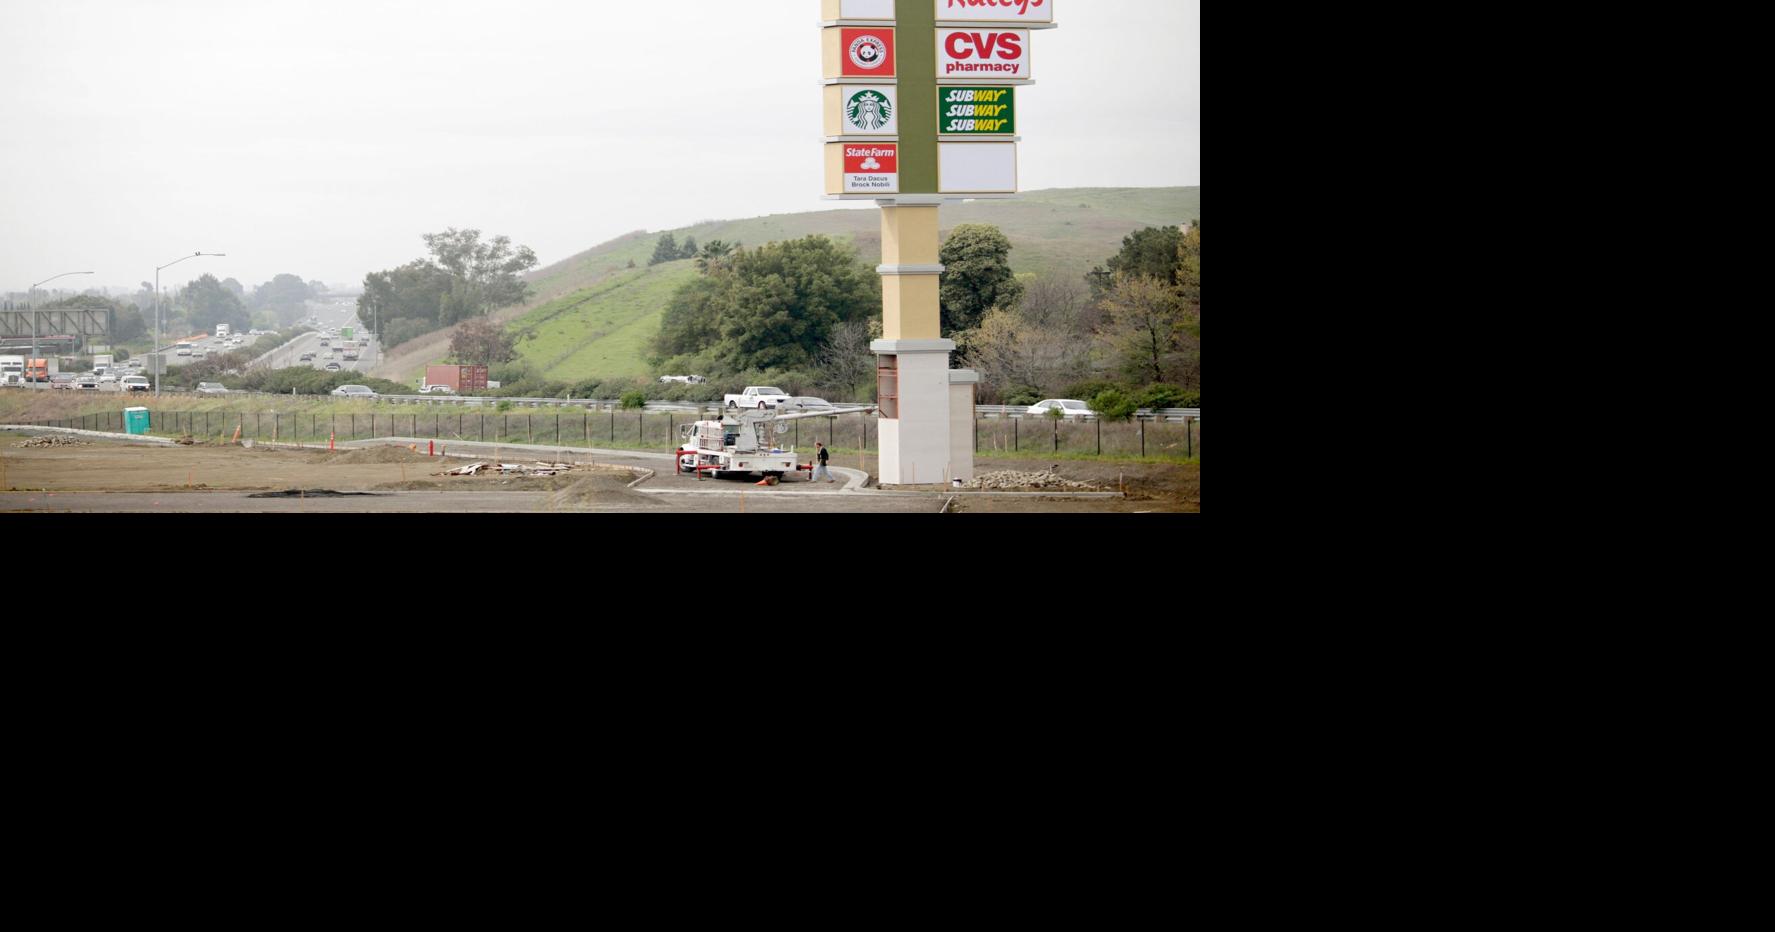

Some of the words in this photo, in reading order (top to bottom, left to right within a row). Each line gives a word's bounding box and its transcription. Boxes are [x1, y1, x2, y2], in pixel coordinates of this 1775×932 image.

[944, 31, 1022, 60] CVS
[946, 61, 1020, 74] pharmacy
[945, 89, 1007, 102] SUBWAY
[945, 104, 1008, 117] SUBWAY
[946, 118, 1008, 131] SUBWAY
